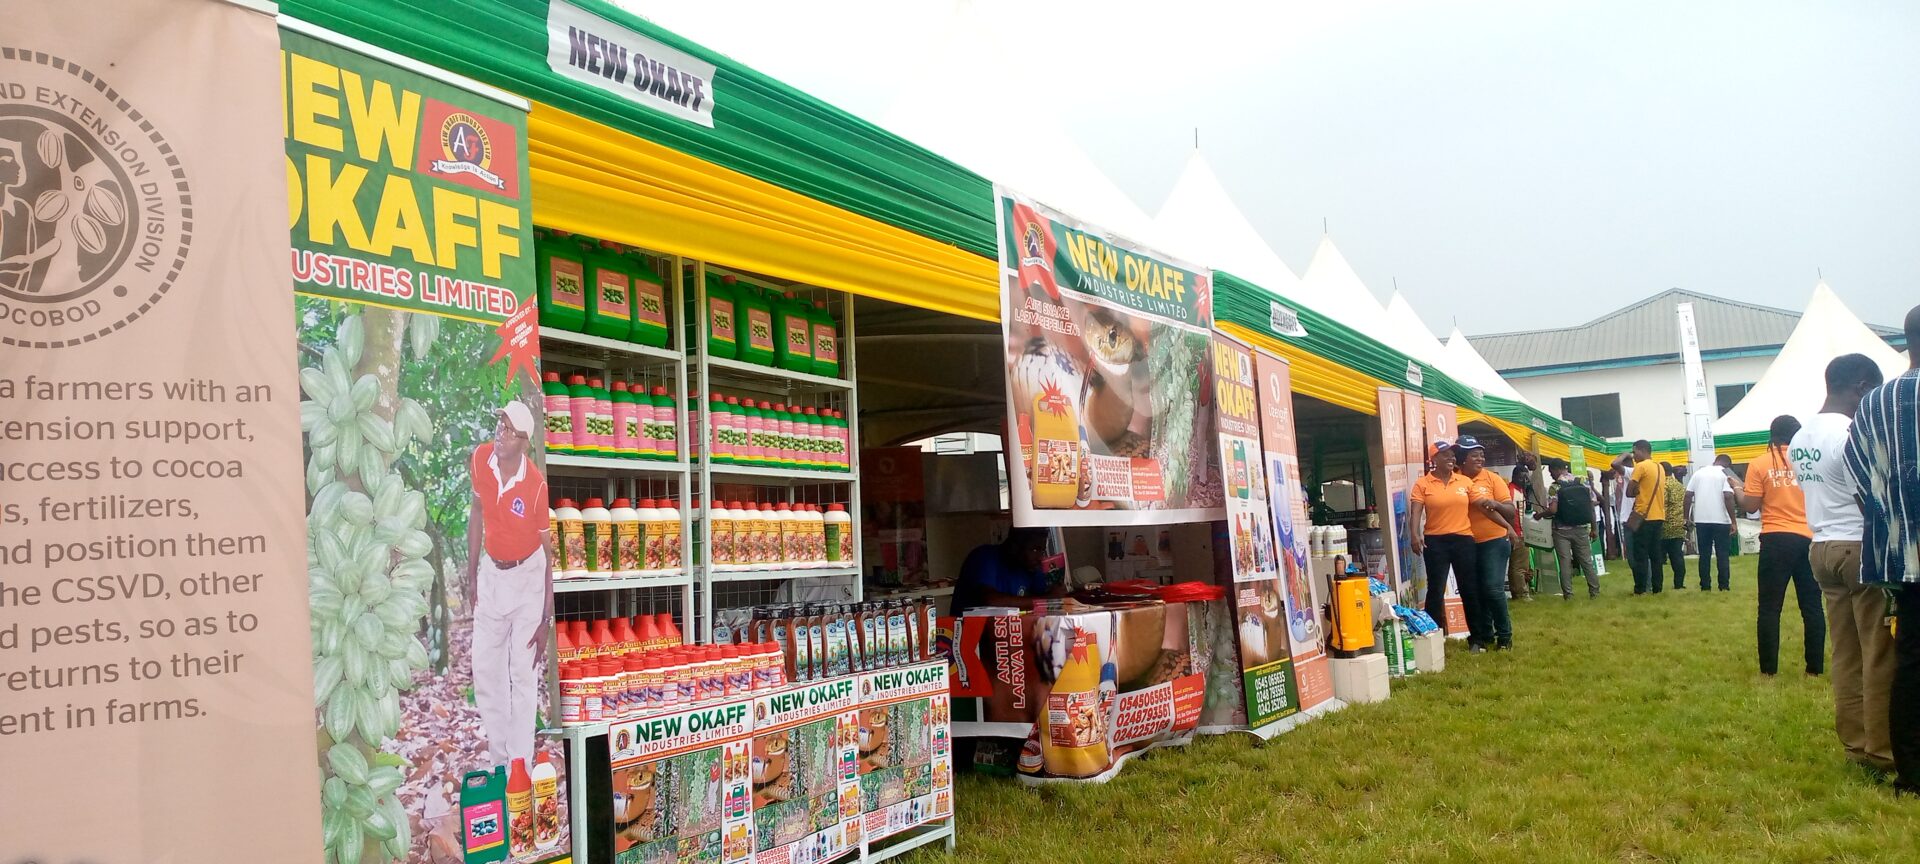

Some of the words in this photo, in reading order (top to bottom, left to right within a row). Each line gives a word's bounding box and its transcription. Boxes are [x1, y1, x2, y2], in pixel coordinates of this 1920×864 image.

[568, 26, 628, 84] NEW
[633, 53, 705, 112] OKAFF
[280, 50, 421, 171] EW
[36, 86, 150, 177] EXTENSION
[135, 182, 165, 272] DIVISION
[1065, 231, 1118, 285] NEW
[1124, 255, 1186, 303] OKAFF
[420, 274, 519, 317] LIMITED
[1077, 274, 1143, 307] INDUSTRIES
[1148, 299, 1188, 320] LIMITED
[1213, 340, 1240, 382] NEW
[25, 375, 153, 401] farmers
[163, 378, 225, 402] with
[235, 384, 272, 403] an
[1217, 379, 1255, 421] OKAFF
[125, 418, 254, 444] support,
[110, 456, 143, 479] to
[152, 459, 243, 479] cocoa
[39, 494, 199, 521] fertilizers,
[45, 533, 176, 568] position
[186, 533, 266, 556] them
[52, 573, 171, 604] CSSVD,
[179, 571, 263, 596] other
[32, 618, 130, 653] pests,
[139, 618, 175, 639] so
[184, 616, 218, 636] as
[226, 610, 258, 633] to
[129, 657, 162, 681] to
[170, 650, 244, 678] their
[874, 673, 903, 692] NEW
[906, 666, 944, 686] OKAFF
[995, 641, 1011, 684] ANTI
[1010, 649, 1026, 709] LARVA
[771, 690, 804, 715] NEW
[808, 680, 853, 706] OKAFF
[877, 686, 915, 699] INDUSTRIES
[917, 681, 943, 692] LIMITED
[1119, 686, 1172, 712] 0545065635
[66, 703, 95, 728] in
[106, 698, 207, 725] farms.
[636, 717, 682, 744] NEW
[688, 704, 746, 733] OKAFF
[774, 706, 821, 724] INDUSTRIES
[823, 697, 851, 715] LIMITED
[640, 733, 701, 754] INDUSTRIES
[705, 724, 744, 740] LIMITED
